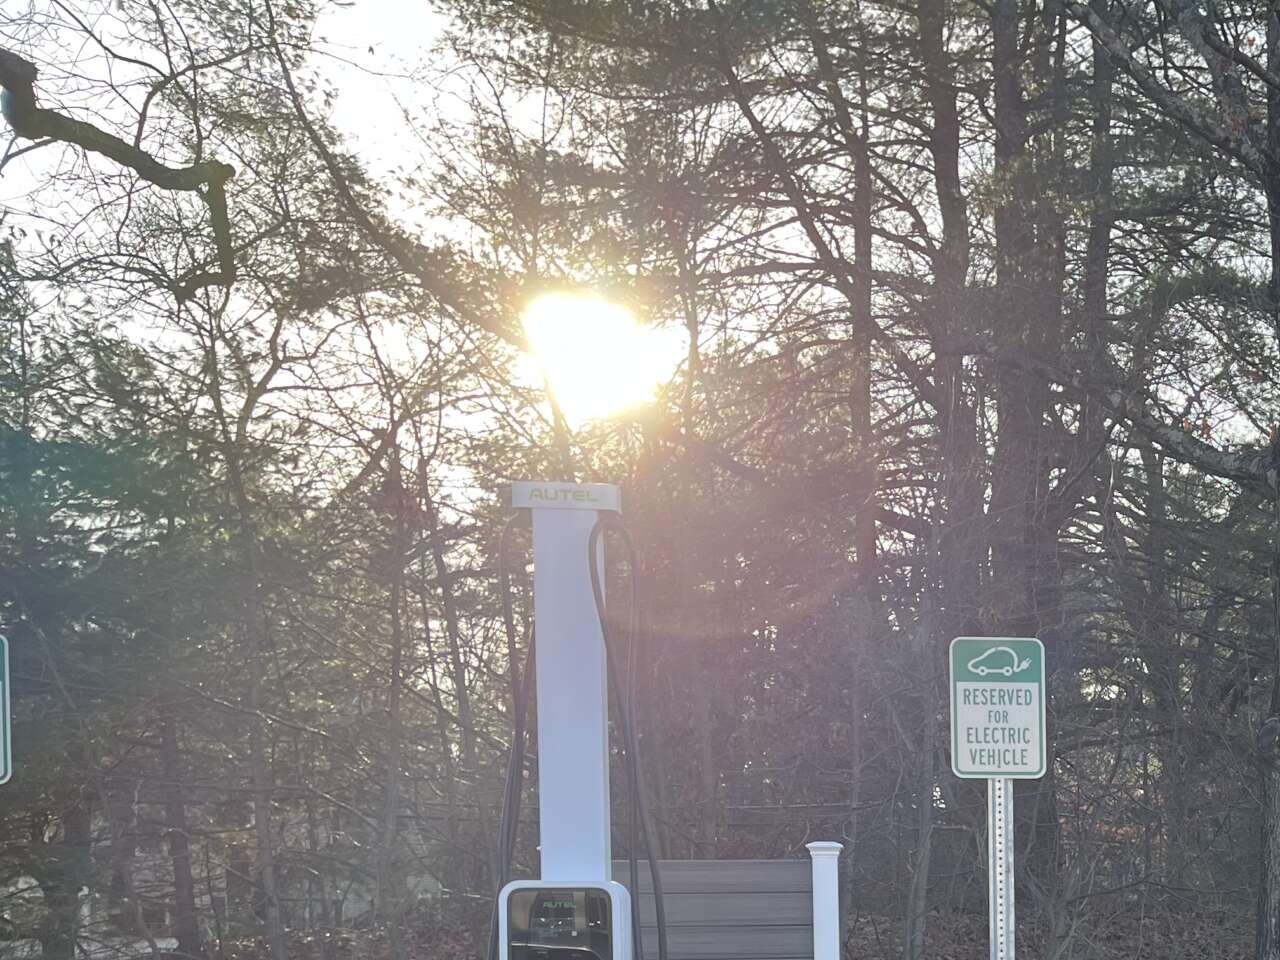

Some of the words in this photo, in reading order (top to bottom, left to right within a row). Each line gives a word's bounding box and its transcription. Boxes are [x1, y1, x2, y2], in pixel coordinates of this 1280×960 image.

[528, 488, 599, 502] AUTEL
[963, 688, 1033, 706] RESERVED
[988, 710, 1009, 724] FOR
[966, 727, 1031, 744] ELECTRIC
[969, 749, 1028, 766] VEHICLE
